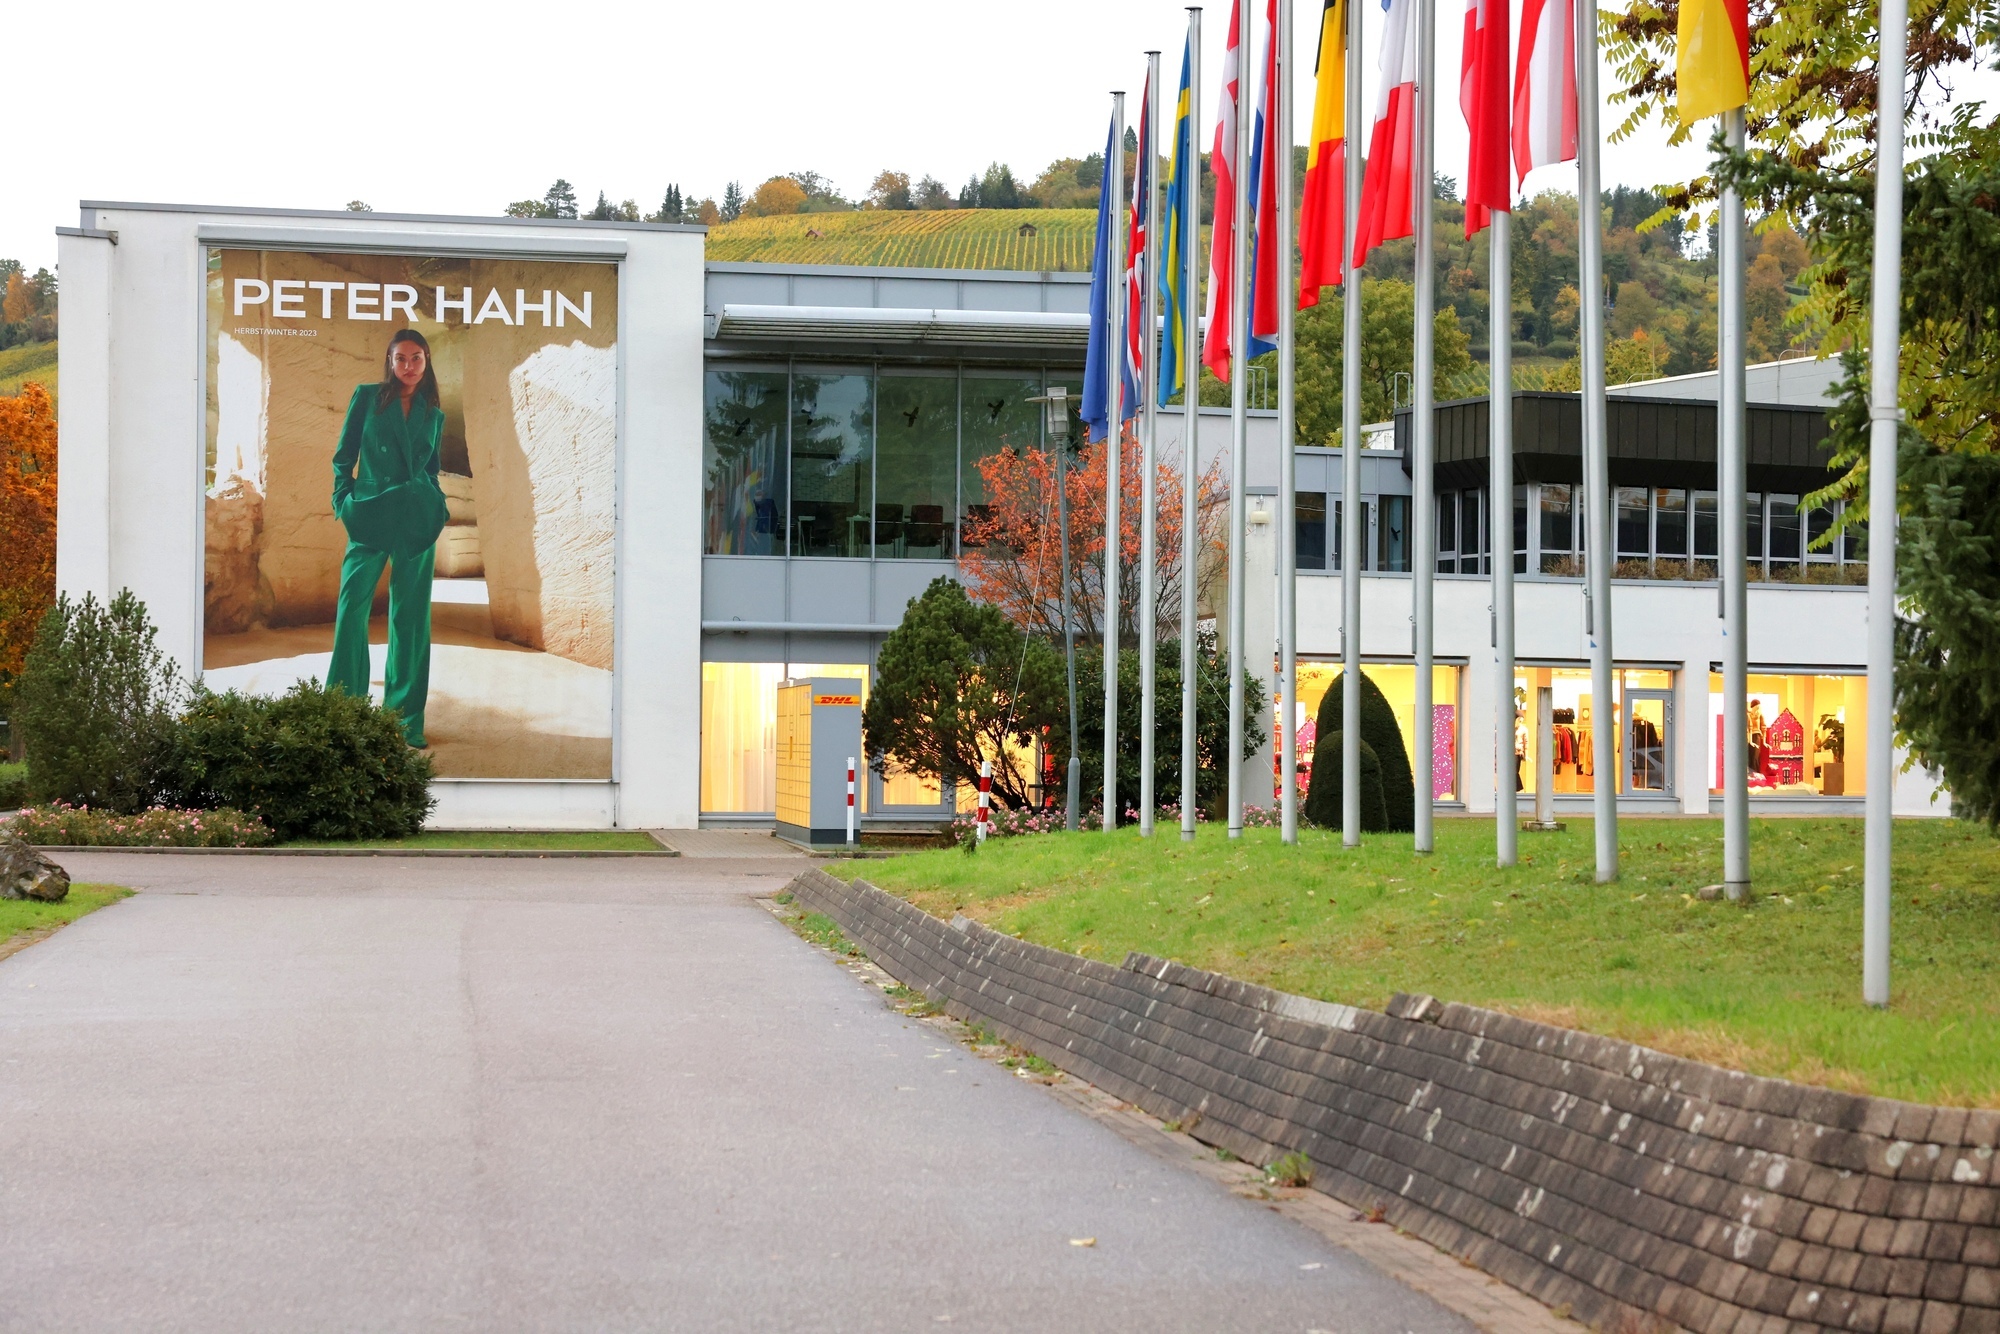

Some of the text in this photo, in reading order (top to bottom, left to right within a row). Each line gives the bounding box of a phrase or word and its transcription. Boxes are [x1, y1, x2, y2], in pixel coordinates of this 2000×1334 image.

[234, 278, 592, 329] PETER HAHN
[234, 327, 317, 337] HERBST/WINTER 2023
[820, 696, 853, 704] DHL
